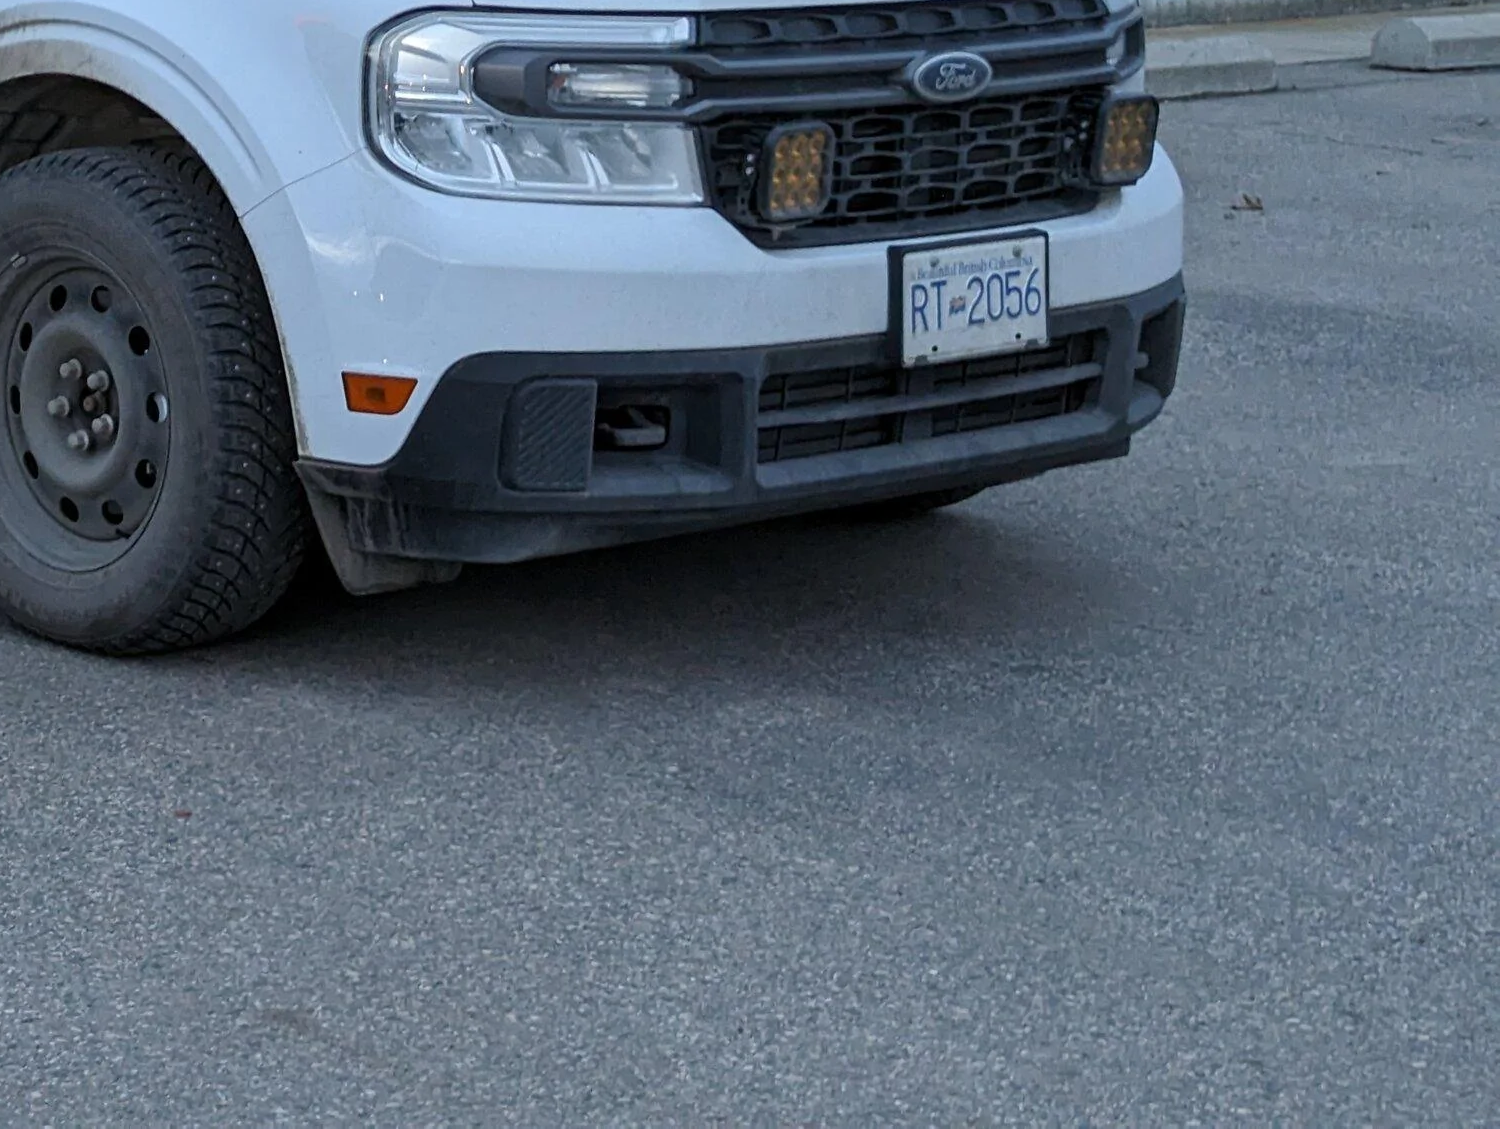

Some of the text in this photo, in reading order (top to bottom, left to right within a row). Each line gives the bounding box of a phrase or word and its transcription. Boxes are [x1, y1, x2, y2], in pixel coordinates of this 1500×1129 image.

[935, 62, 977, 90] Ford
[958, 257, 987, 275] British
[910, 267, 1042, 333] RT 2056
